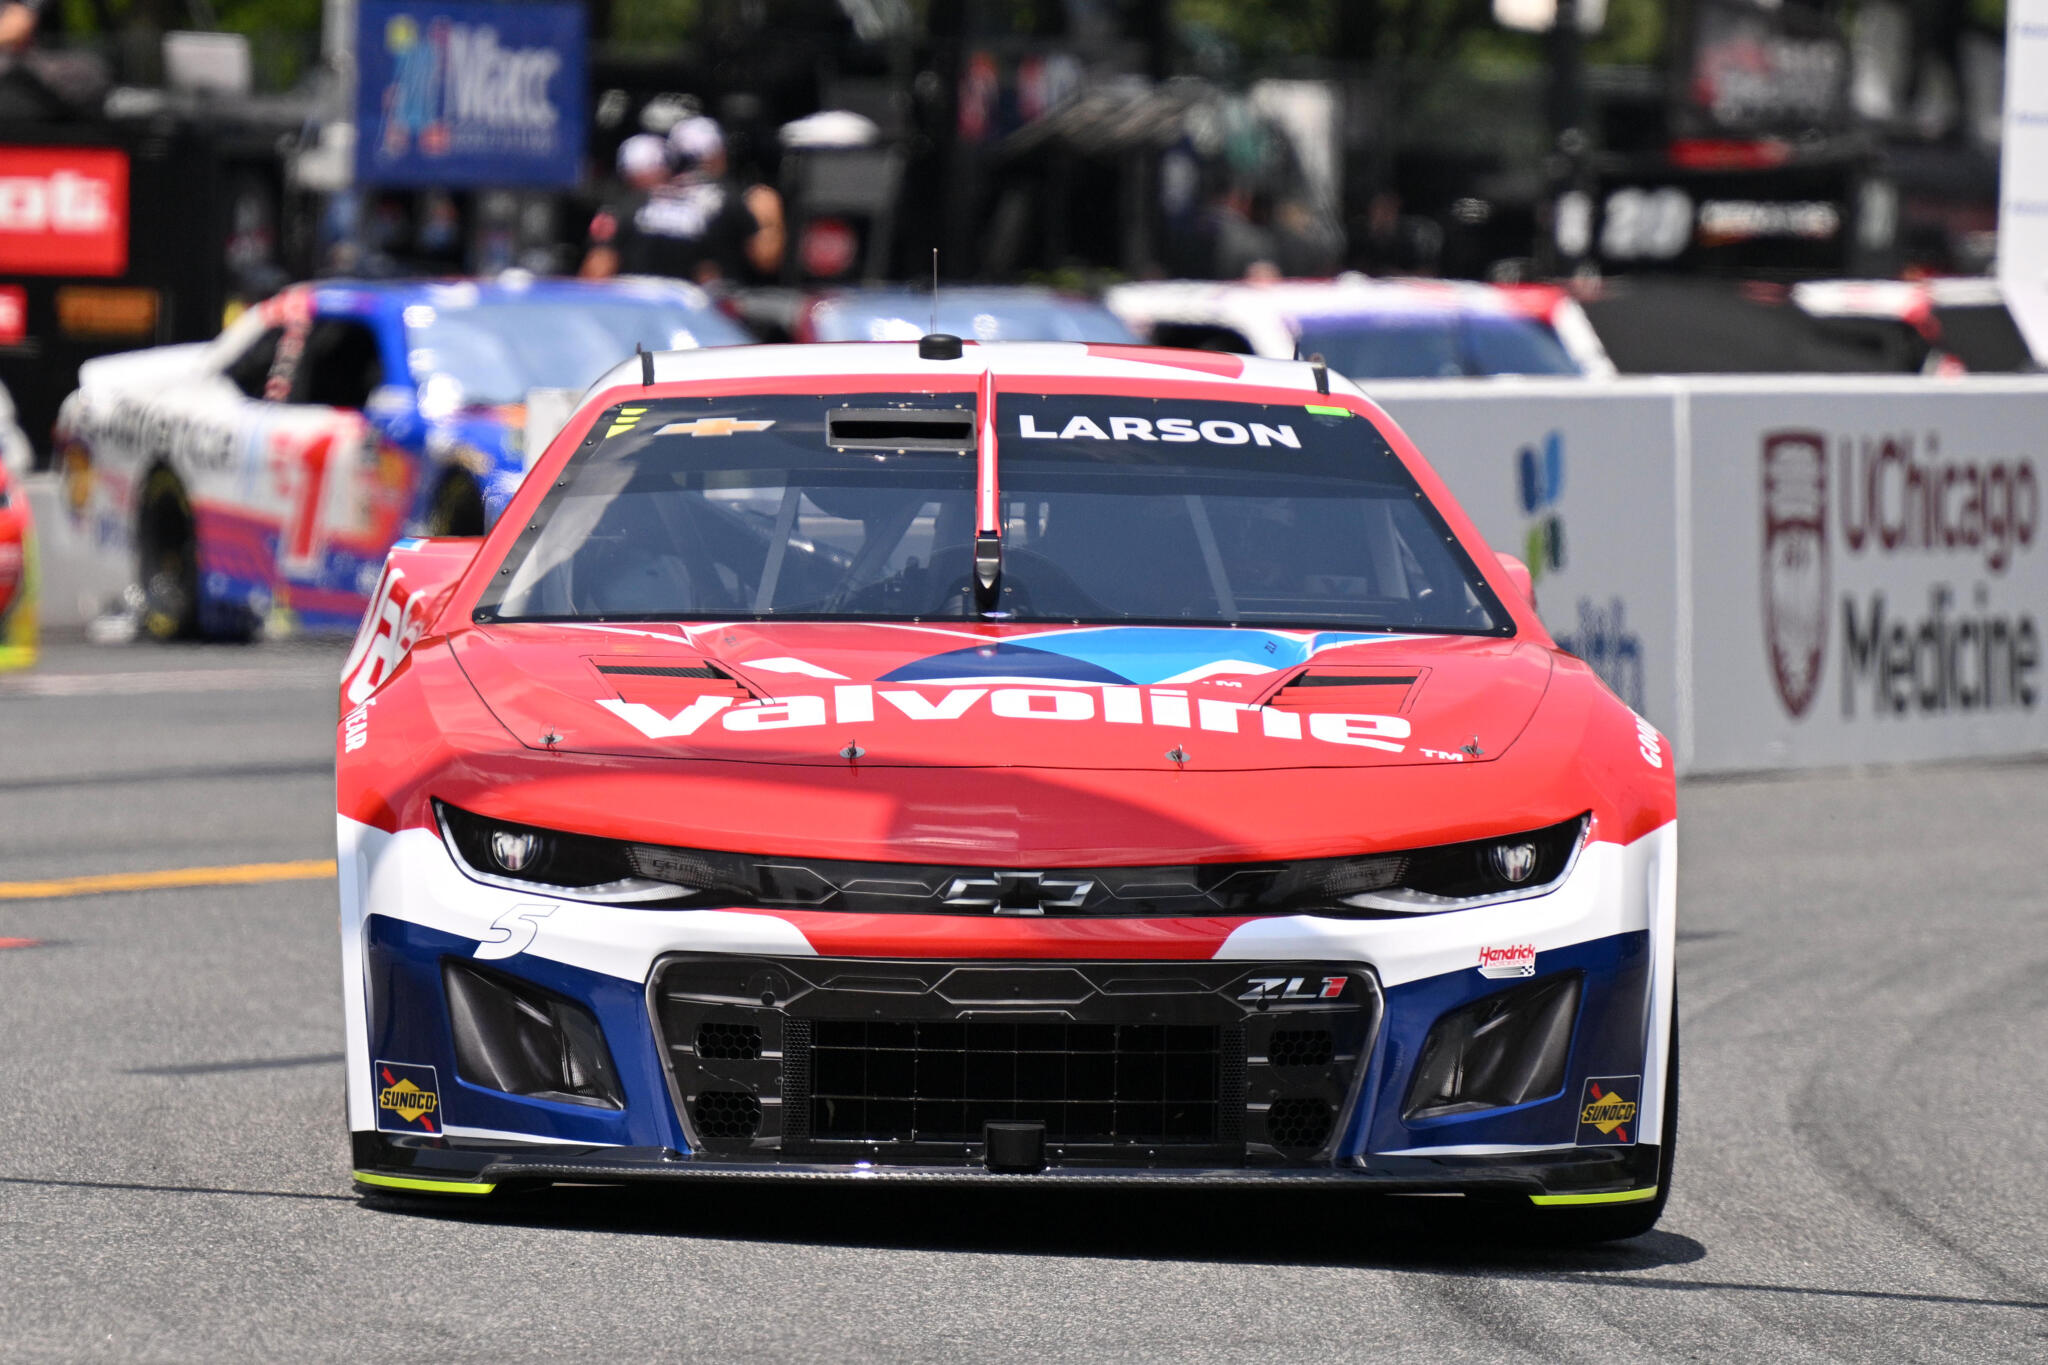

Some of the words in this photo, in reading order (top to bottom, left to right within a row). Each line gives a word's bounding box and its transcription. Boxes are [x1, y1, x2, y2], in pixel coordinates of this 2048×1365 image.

[1019, 415, 1302, 448] LARSON
[1838, 431, 2038, 574] UChicago
[1841, 582, 2041, 720] Medicine
[1419, 748, 1463, 762] TM
[473, 903, 560, 960] 5
[1478, 944, 1536, 967] Hendrick
[1237, 976, 1348, 1000] ZL1
[382, 1090, 434, 1110] SUNOCO
[1584, 1103, 1634, 1122] SUNOCO
